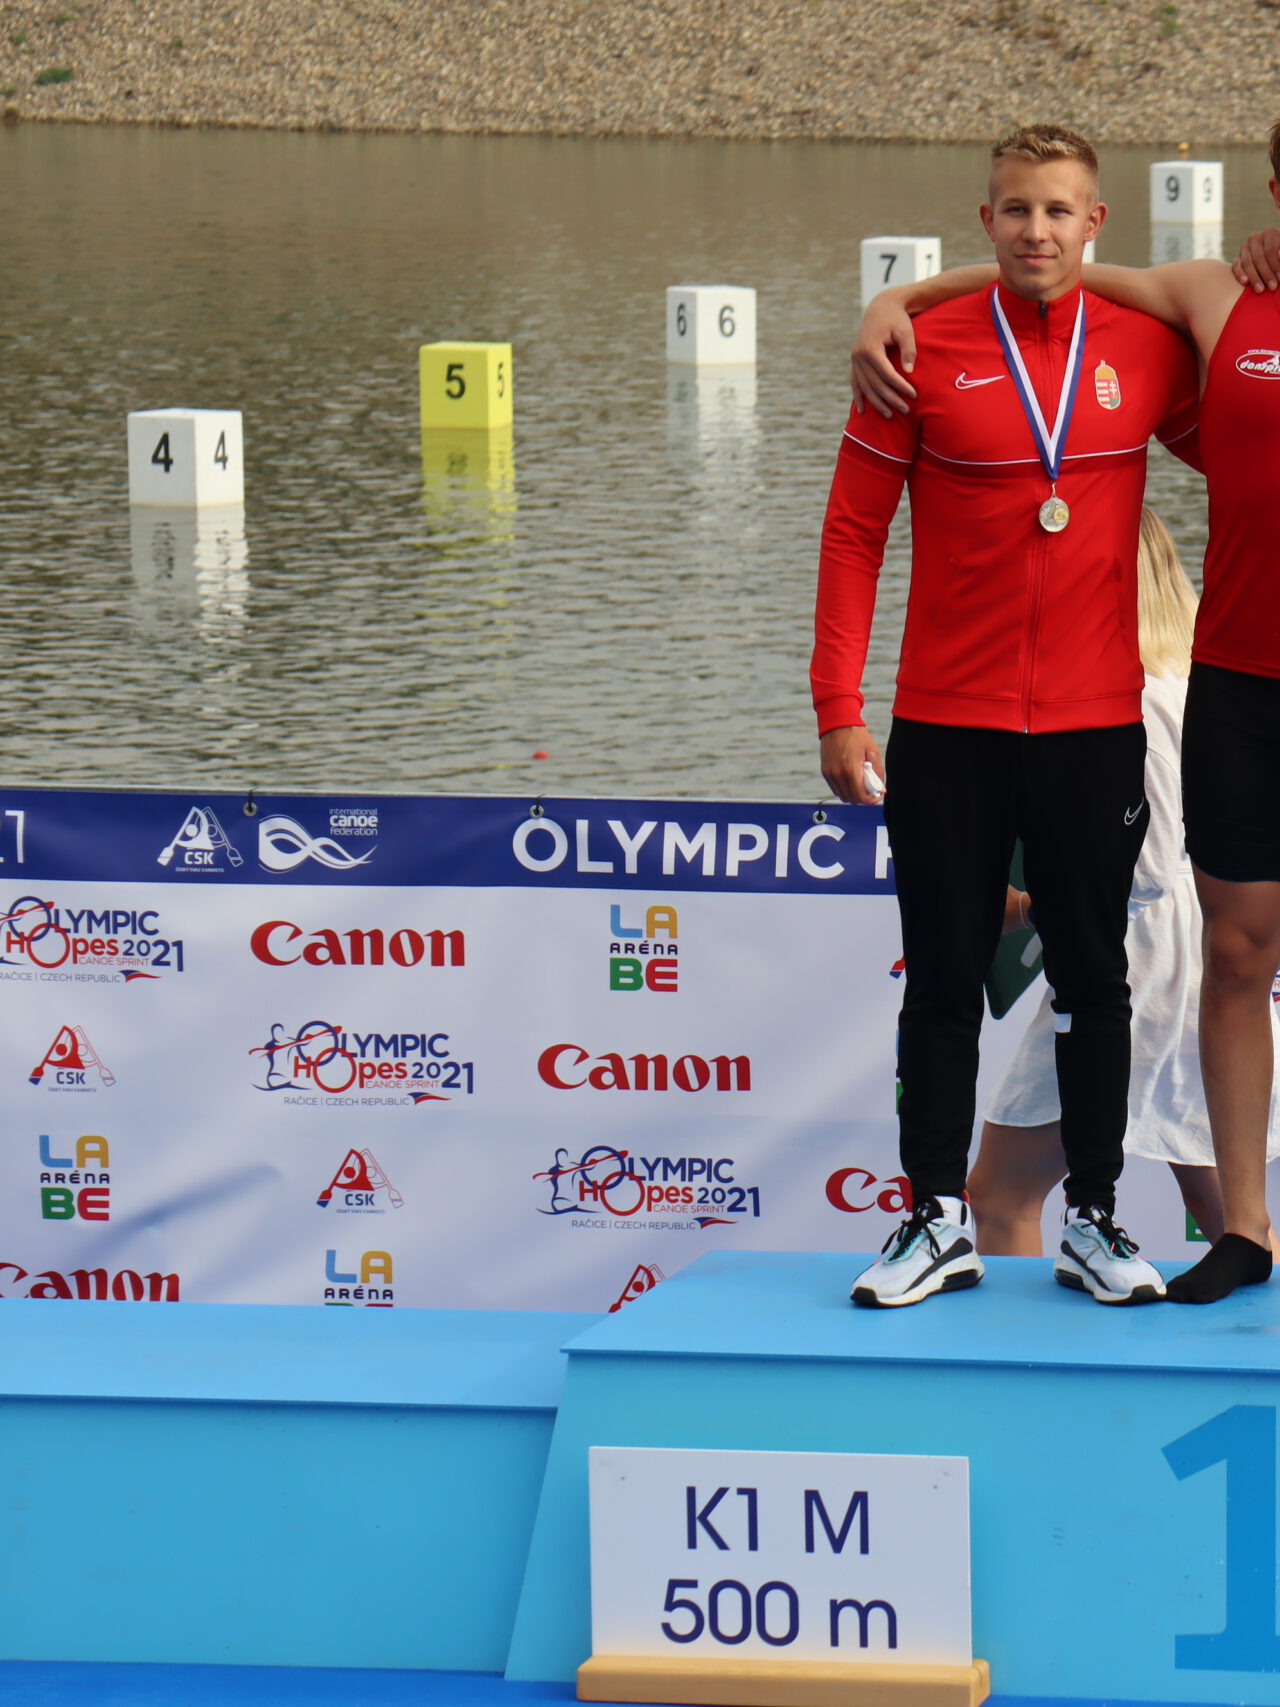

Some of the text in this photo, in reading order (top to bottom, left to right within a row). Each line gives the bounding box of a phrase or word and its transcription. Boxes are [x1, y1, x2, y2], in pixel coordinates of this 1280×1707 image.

[1165, 175, 1179, 202] 9
[879, 254, 897, 284] 7
[676, 302, 687, 337] 6
[718, 305, 736, 338] 6
[445, 364, 466, 400] 5
[496, 362, 505, 398] 5
[152, 432, 174, 474] 4
[213, 430, 229, 472] 4
[330, 815, 378, 827] canoe
[330, 827, 378, 836] federation
[512, 817, 846, 879] OLYMPIC
[8, 896, 159, 941] OLYMPIC
[610, 904, 678, 938] LA
[123, 939, 183, 972] 2021
[250, 920, 465, 967] Canon
[40, 973, 72, 982] CZECH
[75, 974, 120, 983] REPUBLIC
[79, 957, 149, 966] CANOE SPRINT
[609, 958, 678, 992] BE
[296, 1020, 449, 1066] OLYMPIC
[366, 1080, 439, 1089] CANOE SPRINT
[412, 1061, 473, 1094] 2021
[537, 1043, 751, 1092] Canon
[284, 1095, 409, 1106] RAČICE CZECH REPUBLIC
[39, 1135, 109, 1168] LA
[580, 1145, 734, 1190] OLYMPIC
[41, 1187, 110, 1221] BE
[653, 1204, 726, 1213] CANOE SPRINT
[697, 1186, 760, 1217] 2021
[571, 1219, 696, 1230] RAČICE CZECH REPUBLIC
[325, 1250, 393, 1284] LA
[685, 1486, 870, 1556] K1 M
[660, 1578, 898, 1649] 500 m
